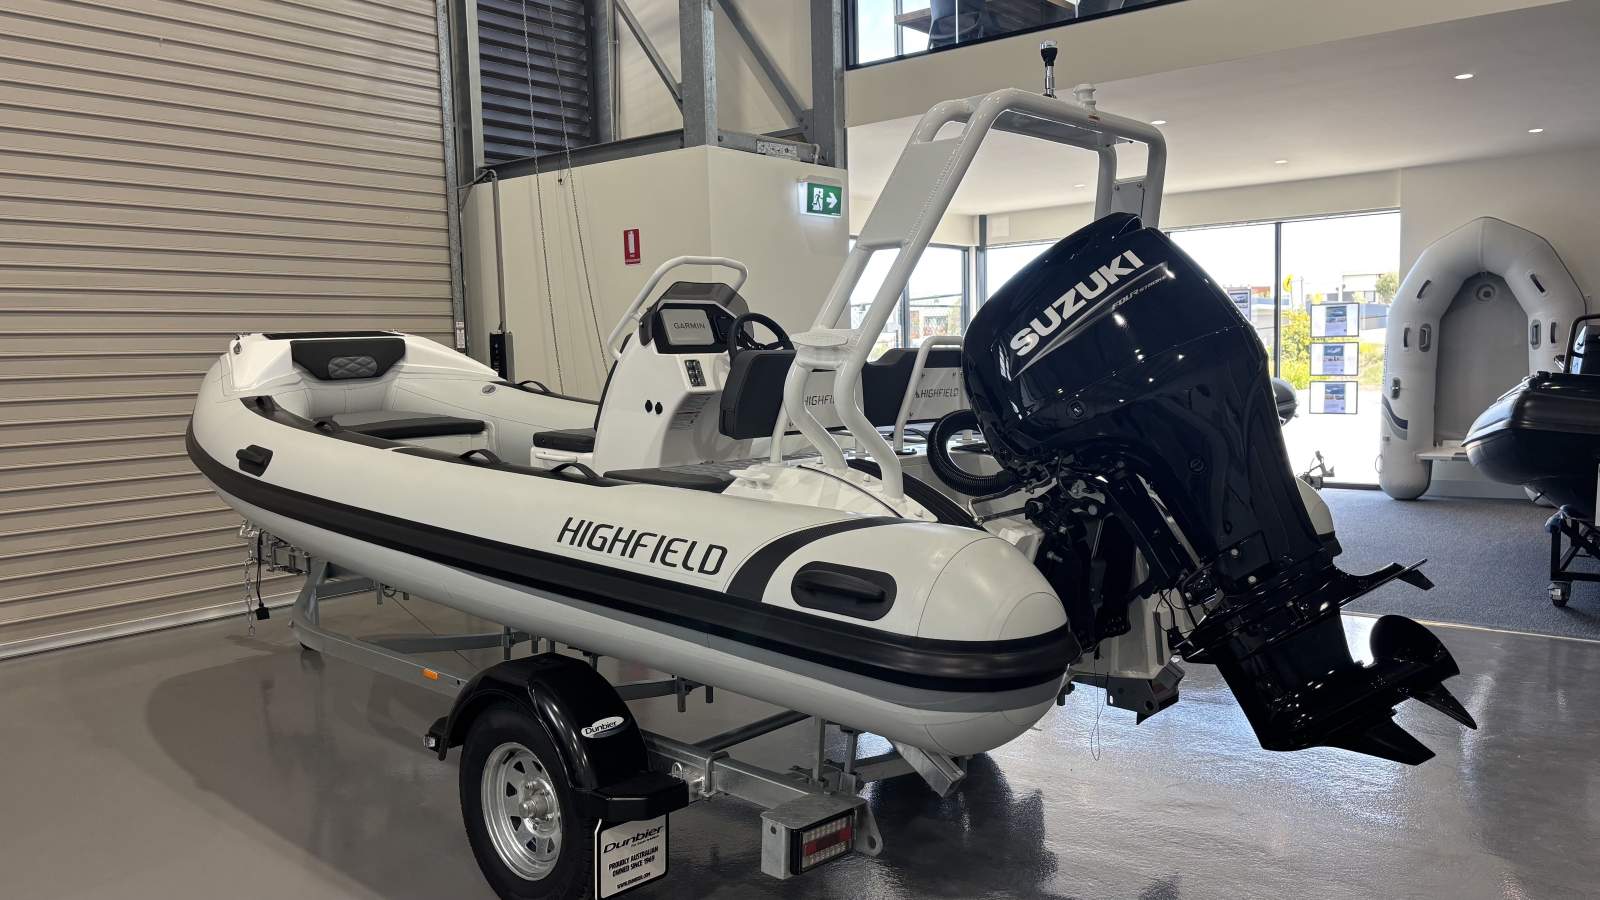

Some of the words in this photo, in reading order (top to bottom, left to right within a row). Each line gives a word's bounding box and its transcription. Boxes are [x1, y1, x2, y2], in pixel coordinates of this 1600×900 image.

[1010, 249, 1144, 356] SUZUKI
[1111, 288, 1139, 311] FOUR
[920, 387, 960, 398] HIGHFIELD
[556, 516, 728, 576] HIGHFIELD
[584, 720, 617, 735] Dunbier
[603, 825, 664, 854] Dunbier
[608, 856, 630, 871] PROUDLY
[630, 845, 659, 862] AUSTRALIAN
[612, 864, 630, 878] OWNED
[630, 860, 643, 871] SINCE
